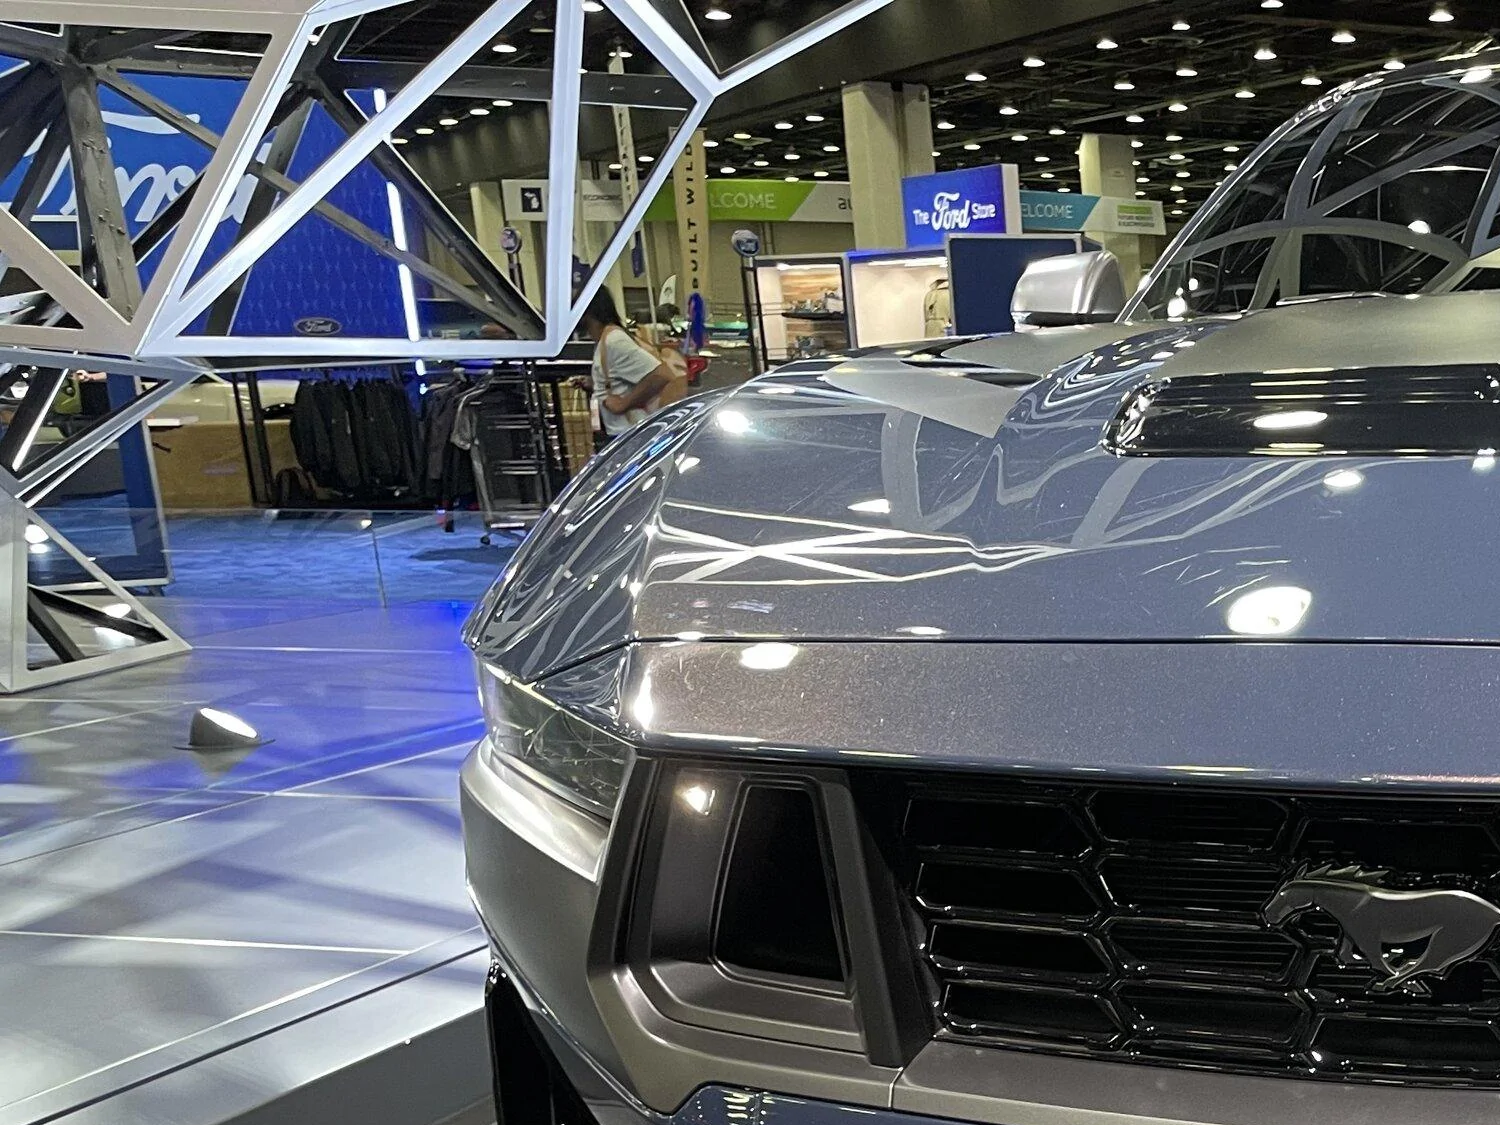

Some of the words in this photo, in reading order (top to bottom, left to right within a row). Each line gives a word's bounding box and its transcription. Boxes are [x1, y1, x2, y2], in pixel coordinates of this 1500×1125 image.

[685, 143, 695, 205] WILD
[709, 192, 777, 209] LCOME
[913, 209, 929, 225] The
[932, 192, 971, 231] Ford
[1020, 202, 1073, 219] ELCOME
